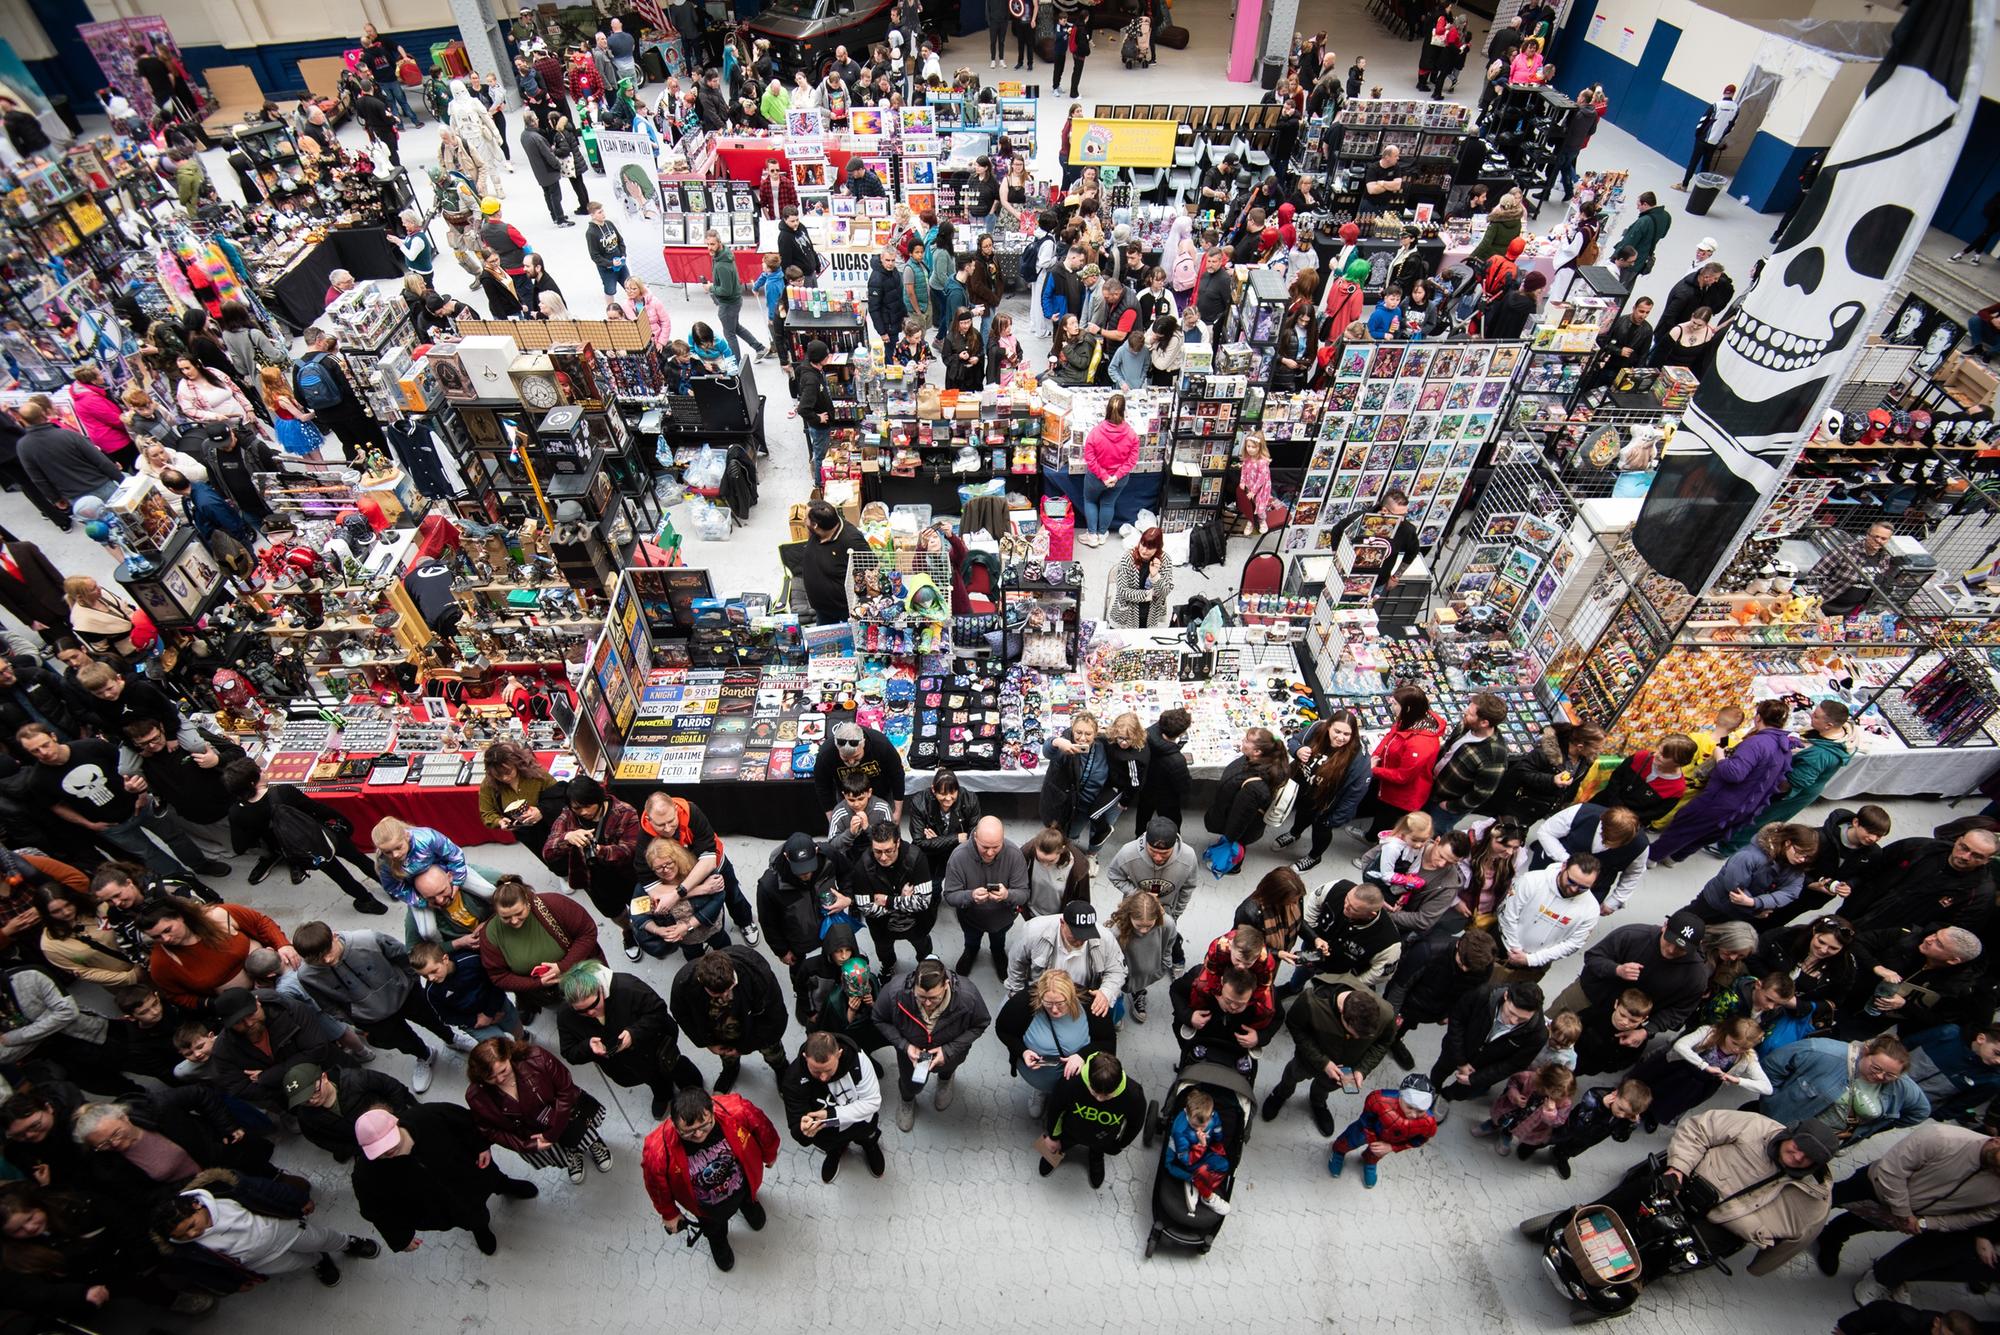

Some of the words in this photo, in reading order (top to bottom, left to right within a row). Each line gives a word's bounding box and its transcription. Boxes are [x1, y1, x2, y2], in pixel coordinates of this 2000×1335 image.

[603, 139, 618, 152] CAN
[619, 139, 637, 153] DRAW
[638, 141, 651, 155] YOU
[831, 253, 869, 271] LUCAS
[762, 681, 805, 689] AMITYVILLE
[649, 690, 678, 700] KNIGHT
[694, 687, 718, 697] 98Y5
[721, 686, 757, 698] Bandit
[707, 701, 717, 710] 18
[677, 717, 711, 728] TARDIS
[663, 751, 702, 761] OUTATIME
[623, 763, 654, 774] ECTO-1
[1076, 913, 1097, 925] ICON
[1073, 1102, 1125, 1126] XBOX
